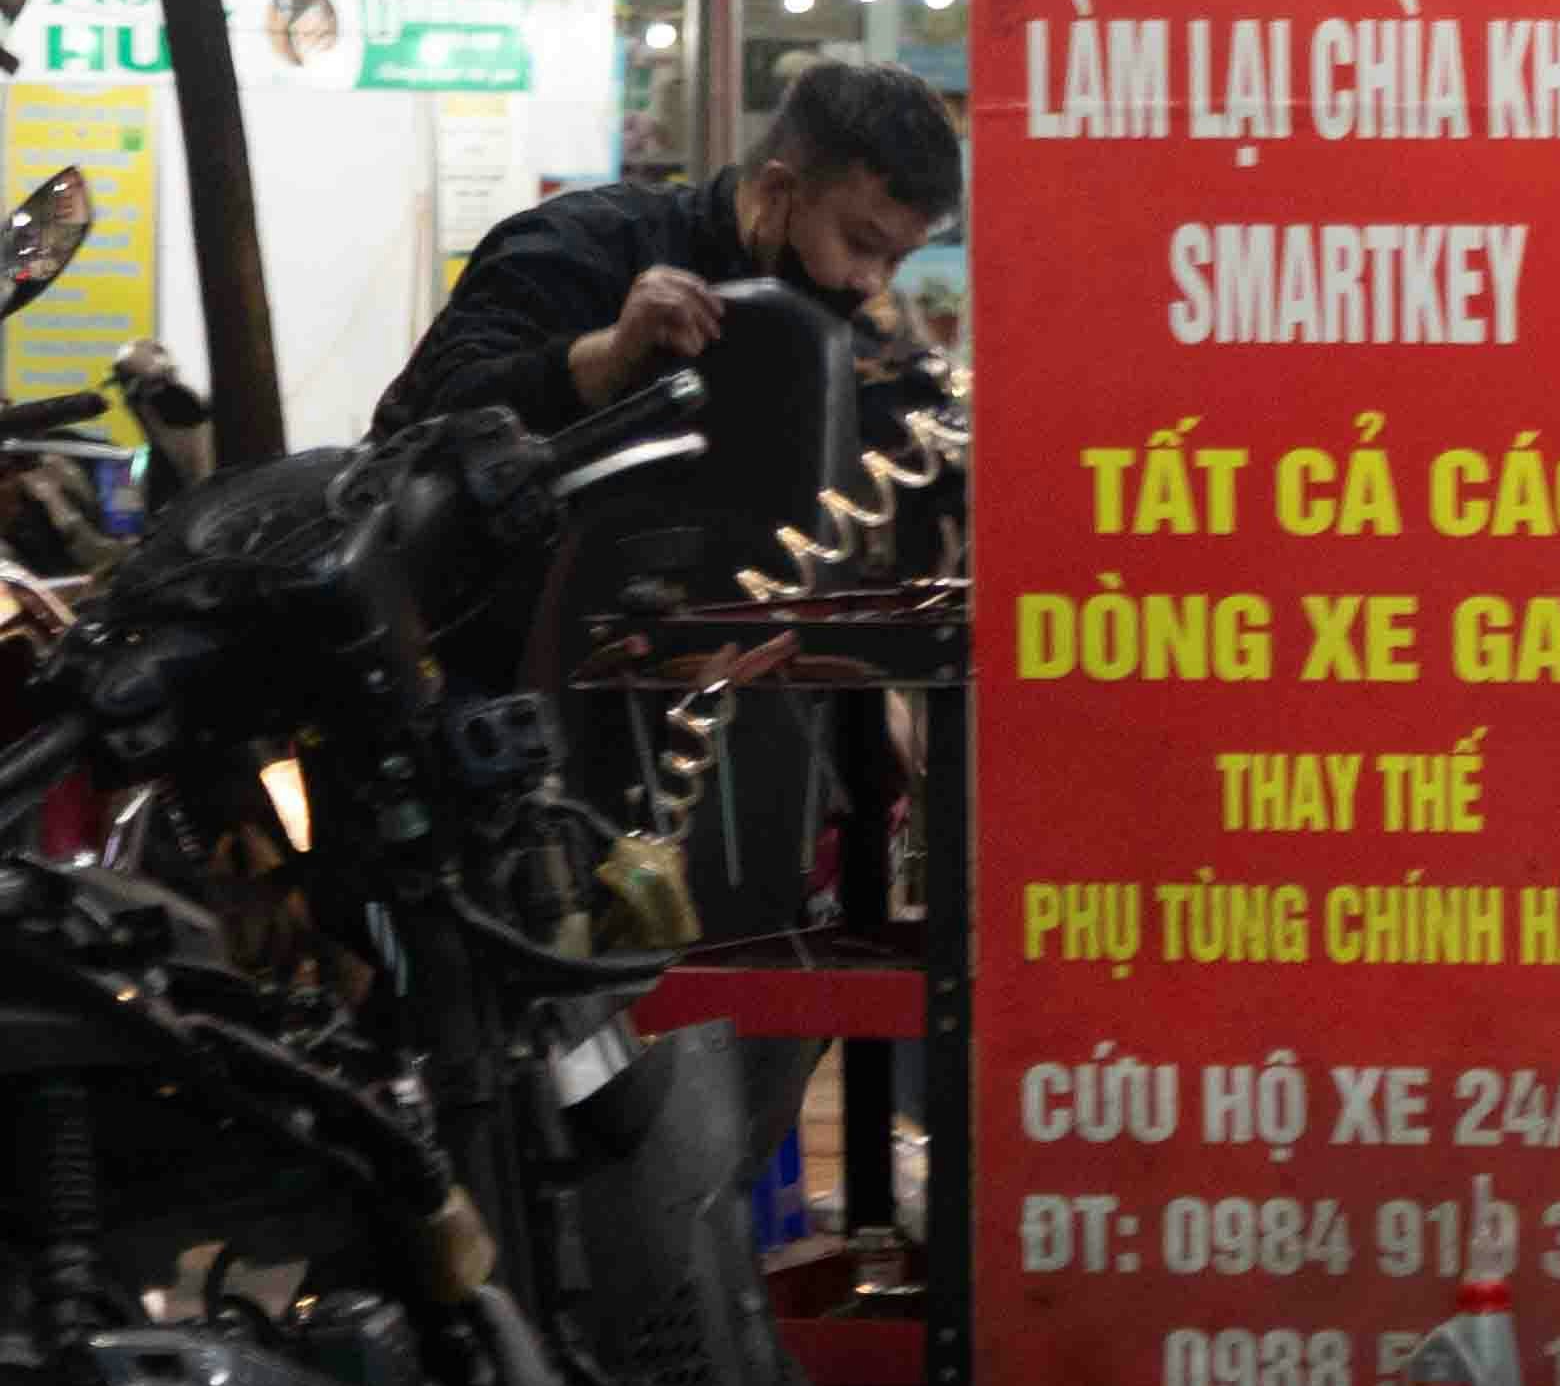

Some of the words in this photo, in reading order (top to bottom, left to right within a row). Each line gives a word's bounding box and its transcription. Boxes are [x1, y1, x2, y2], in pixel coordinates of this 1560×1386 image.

[1188, 18, 1293, 167] LẠI
[1170, 222, 1529, 344] SMARTKEY
[1081, 416, 1249, 535] TẤT
[1276, 411, 1401, 536] CẢ
[1018, 572, 1271, 682] DÒNG
[1301, 595, 1418, 682] XE
[1216, 753, 1362, 832] THAY
[1375, 726, 1488, 833] THẾ
[1023, 882, 1141, 979] PHỤ
[1156, 867, 1309, 963] TÙNG
[1325, 869, 1504, 965] CHÍNH
[1021, 1040, 1179, 1143] CỨU
[1202, 1049, 1307, 1162] HỘ
[1331, 1066, 1431, 1145] XE
[1019, 1194, 1139, 1273] ĐT:
[1162, 1196, 1353, 1275] 0984
